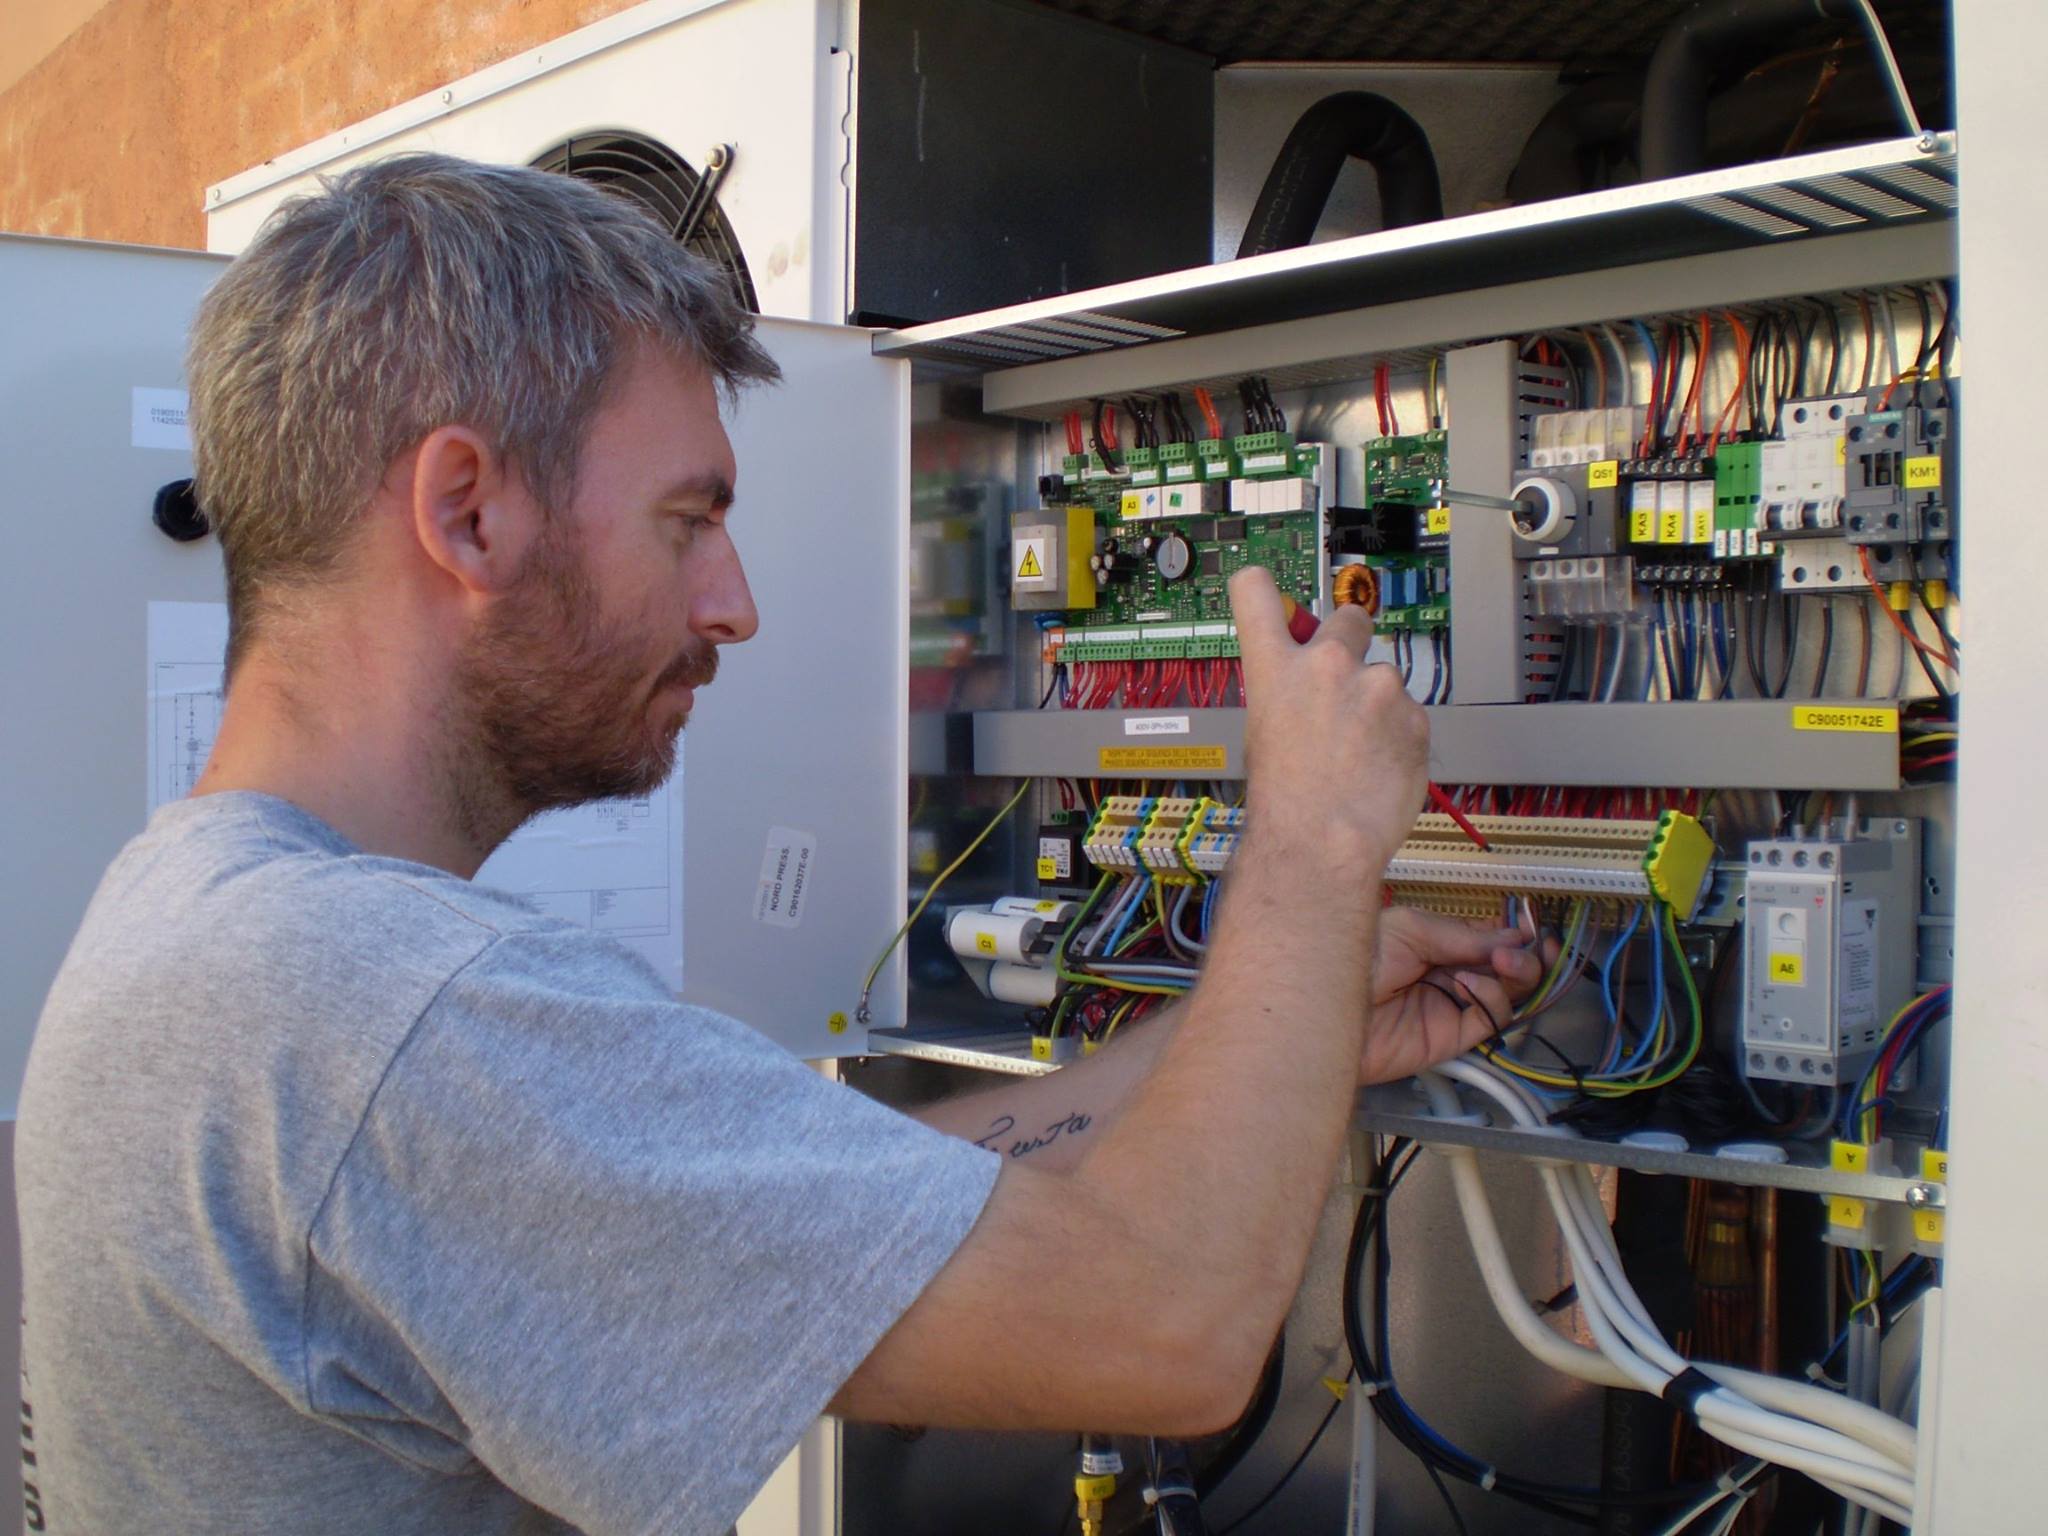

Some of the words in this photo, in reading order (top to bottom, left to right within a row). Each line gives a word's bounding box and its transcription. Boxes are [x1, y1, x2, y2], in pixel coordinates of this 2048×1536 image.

[1592, 469, 1613, 480] QS1
[1909, 466, 1937, 478] KM1
[1637, 512, 1648, 537] KA3
[1666, 513, 1677, 538] KA4
[1807, 713, 1885, 728] C90051742E
[770, 880, 783, 912] NORD
[1780, 963, 1795, 974] A6
[1846, 1153, 1856, 1163] A
[1844, 1207, 1853, 1217] A
[1927, 1220, 1936, 1232] B
